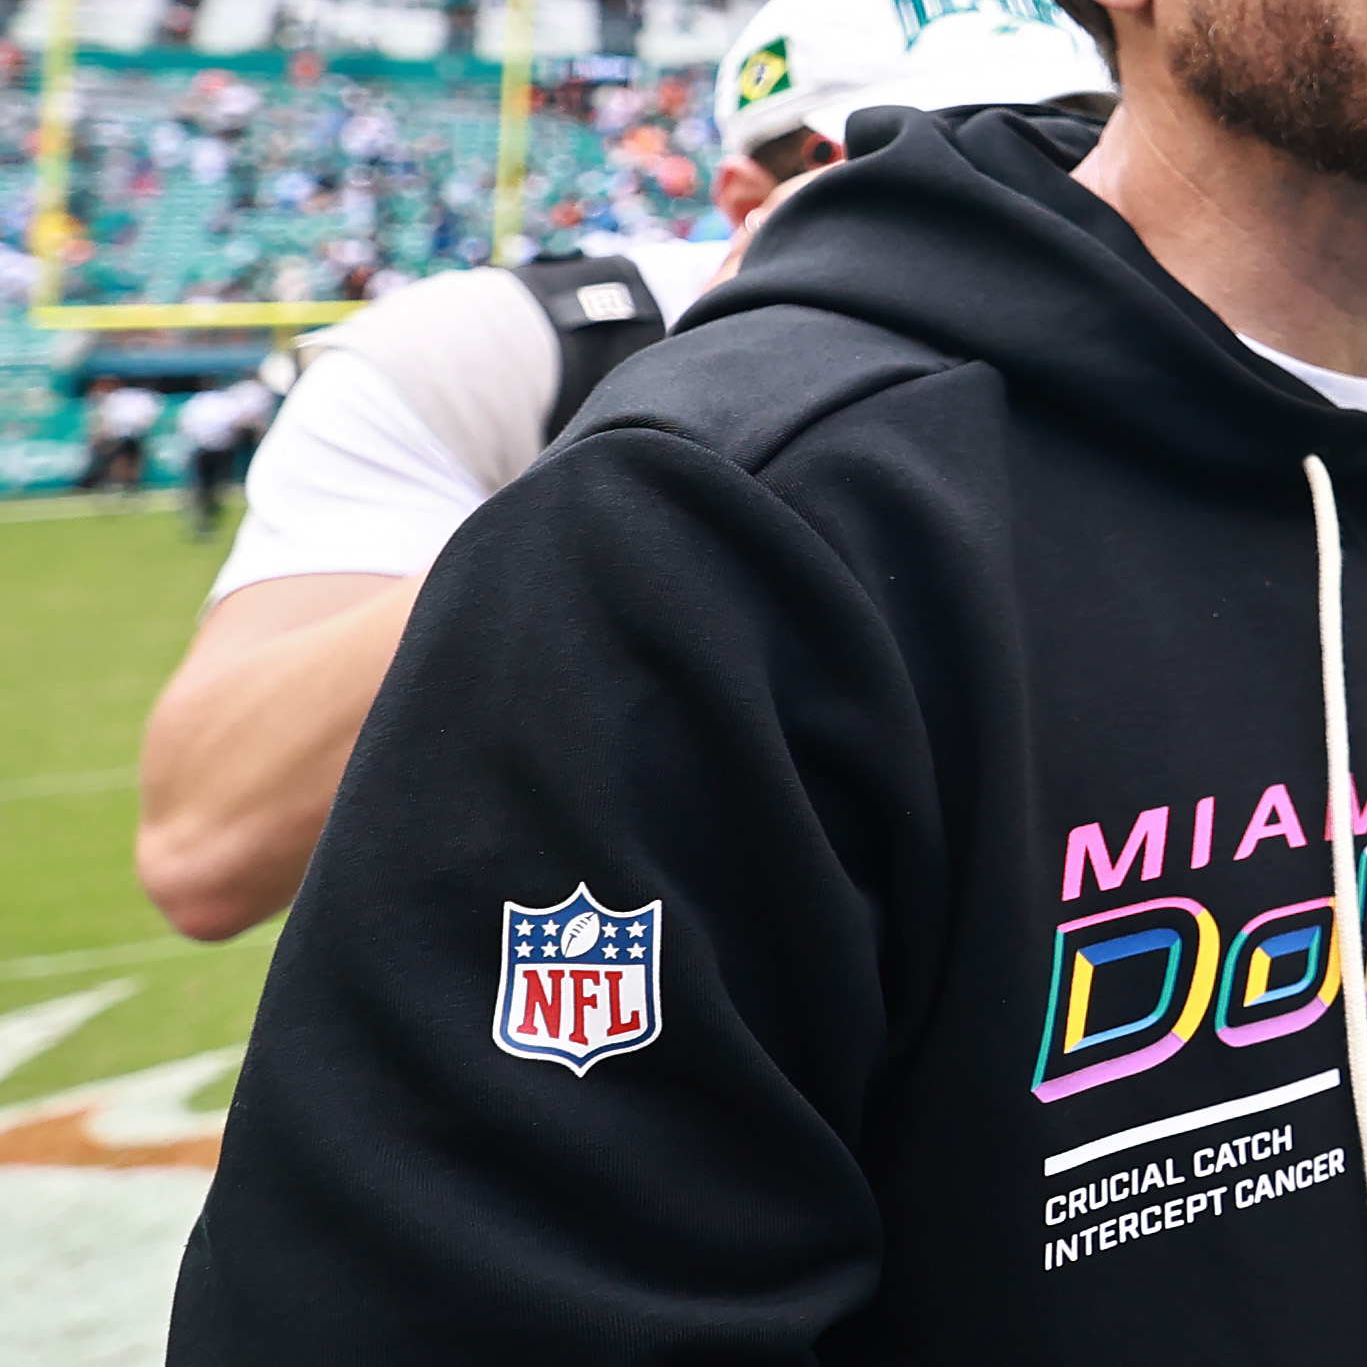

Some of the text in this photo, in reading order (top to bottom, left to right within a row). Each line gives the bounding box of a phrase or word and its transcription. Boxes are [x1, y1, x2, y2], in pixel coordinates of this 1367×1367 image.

[516, 969, 641, 1046] NFL
[1045, 1124, 1293, 1226] CRUCIAL CATCH
[1045, 1148, 1346, 1270] INTERCEPT CANCER
